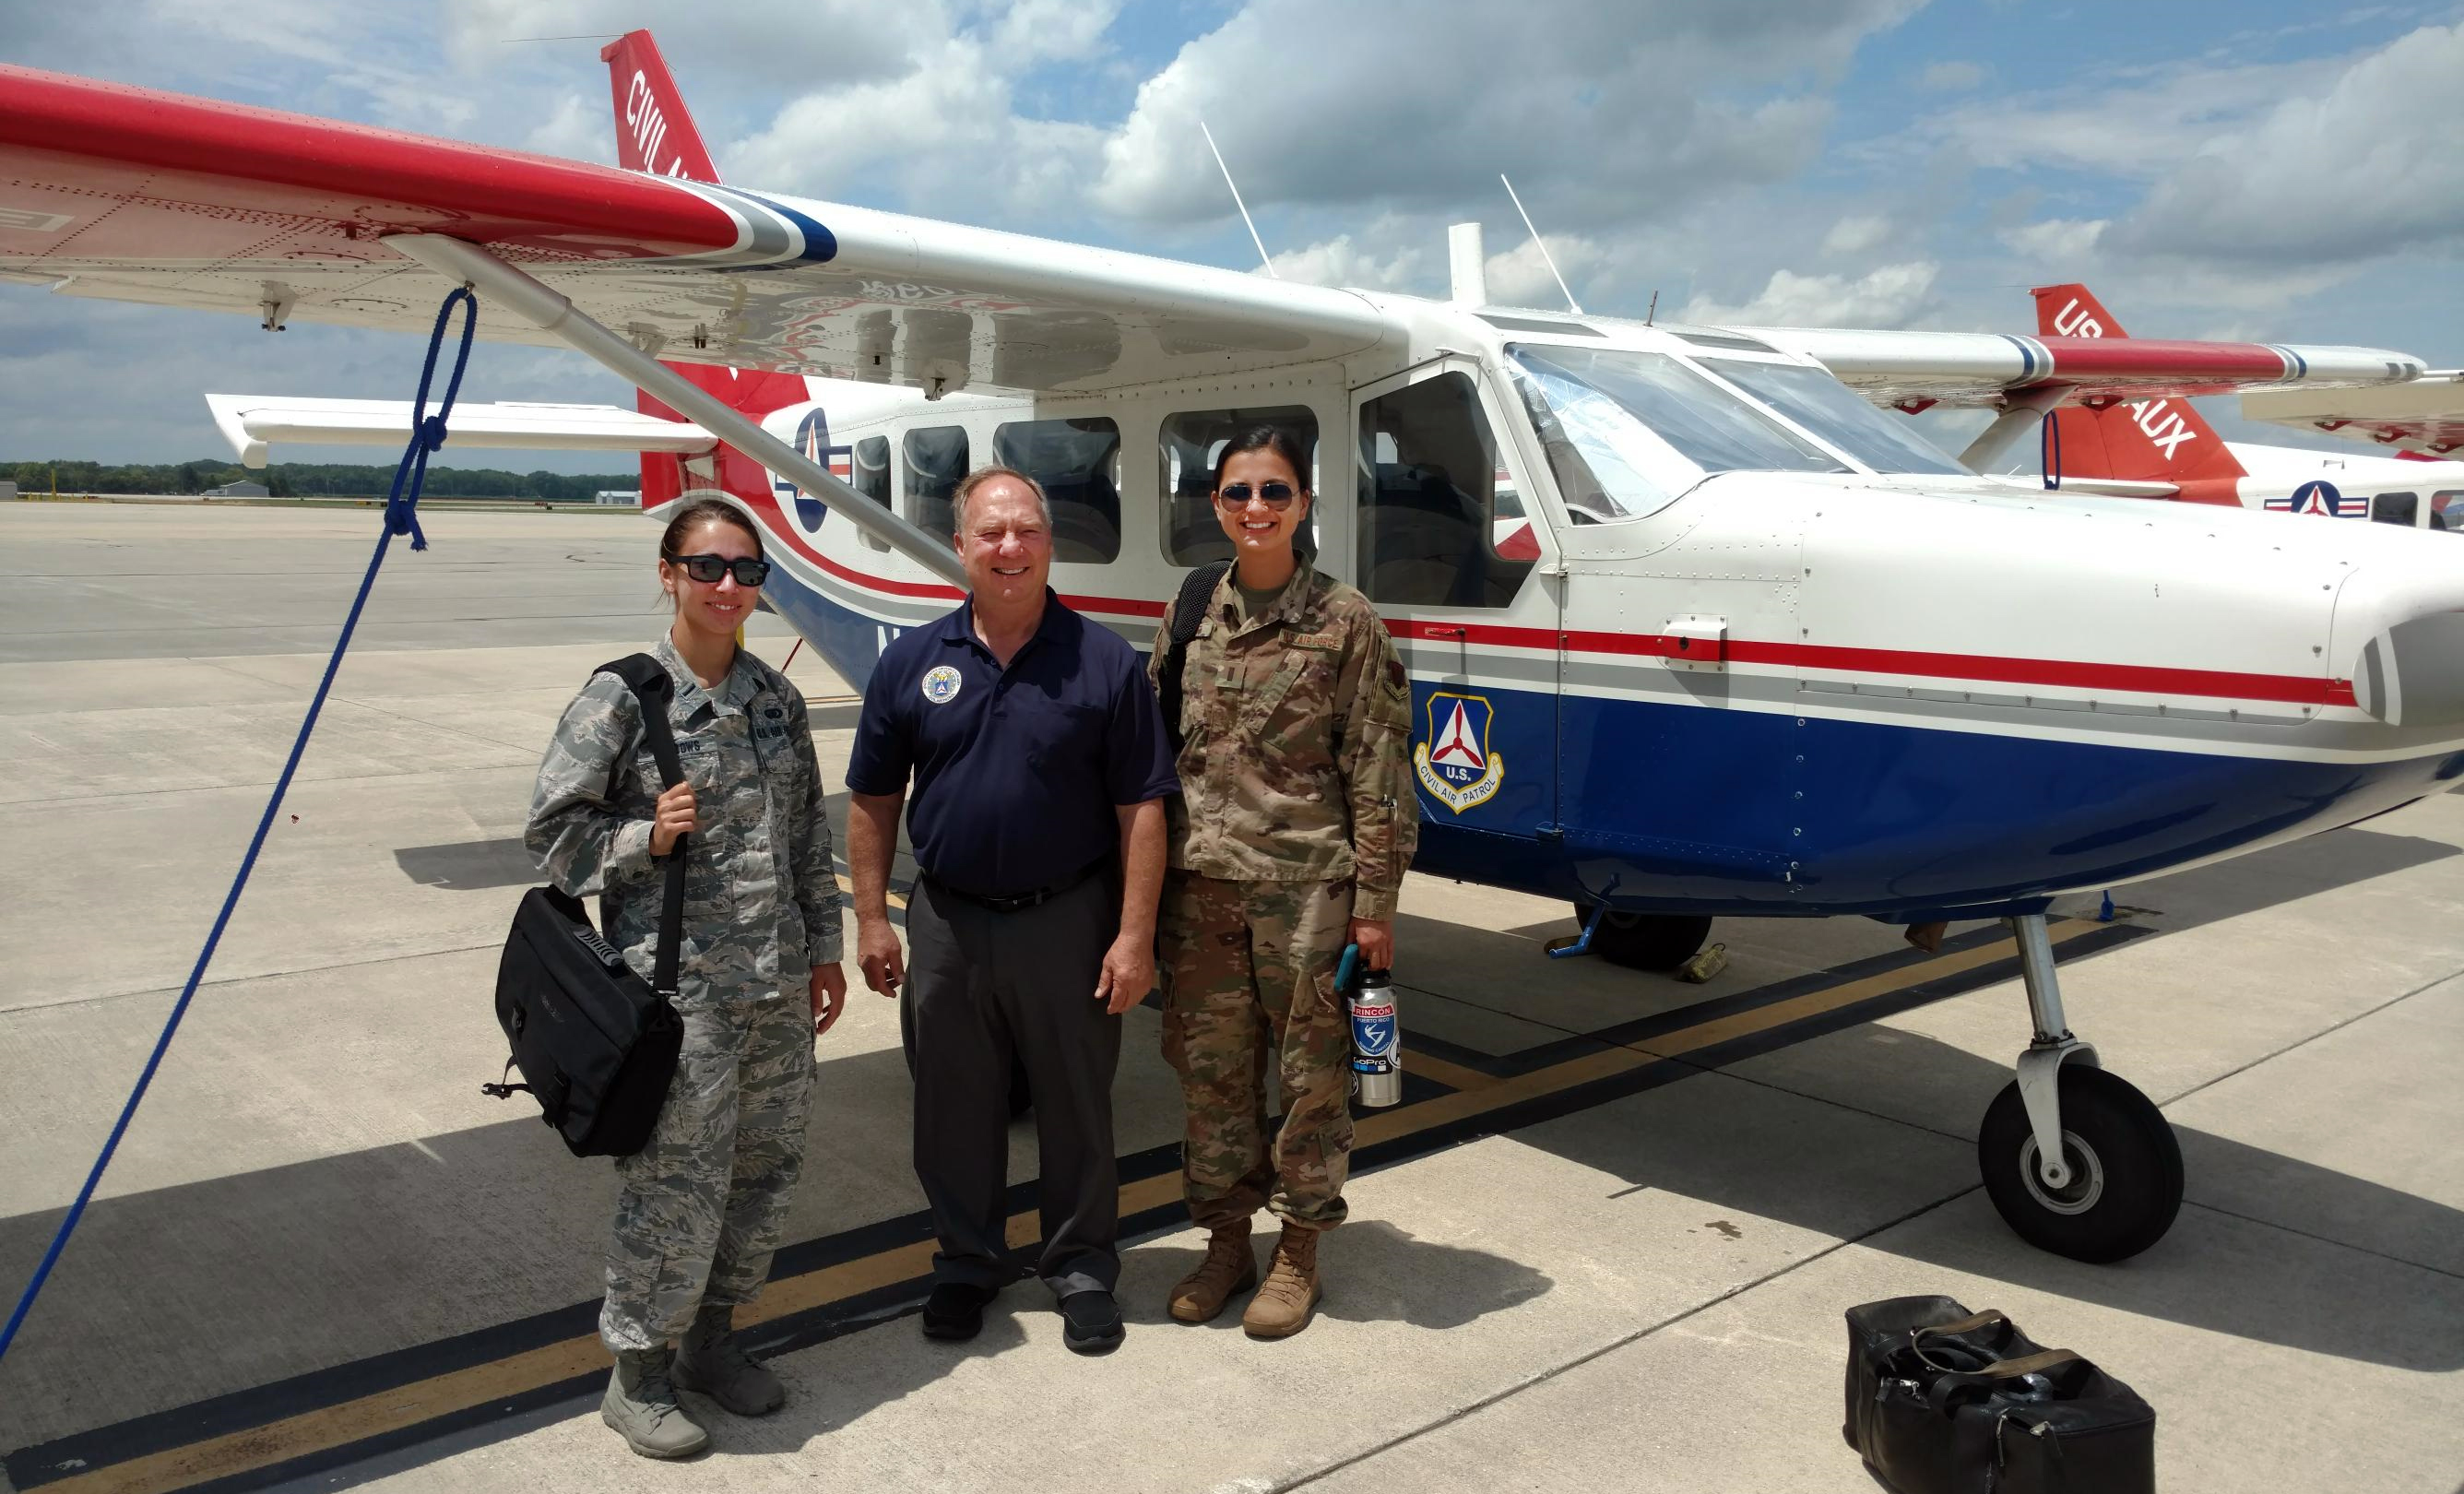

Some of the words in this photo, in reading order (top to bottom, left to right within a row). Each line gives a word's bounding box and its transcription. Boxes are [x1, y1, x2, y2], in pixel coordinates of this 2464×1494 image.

[2121, 398, 2197, 461] AUX
[1420, 765, 1439, 792] CIVIL
[1441, 788, 1457, 804] AIR
[1463, 777, 1496, 803] PATROL
[1446, 766, 1472, 781] U.S.
